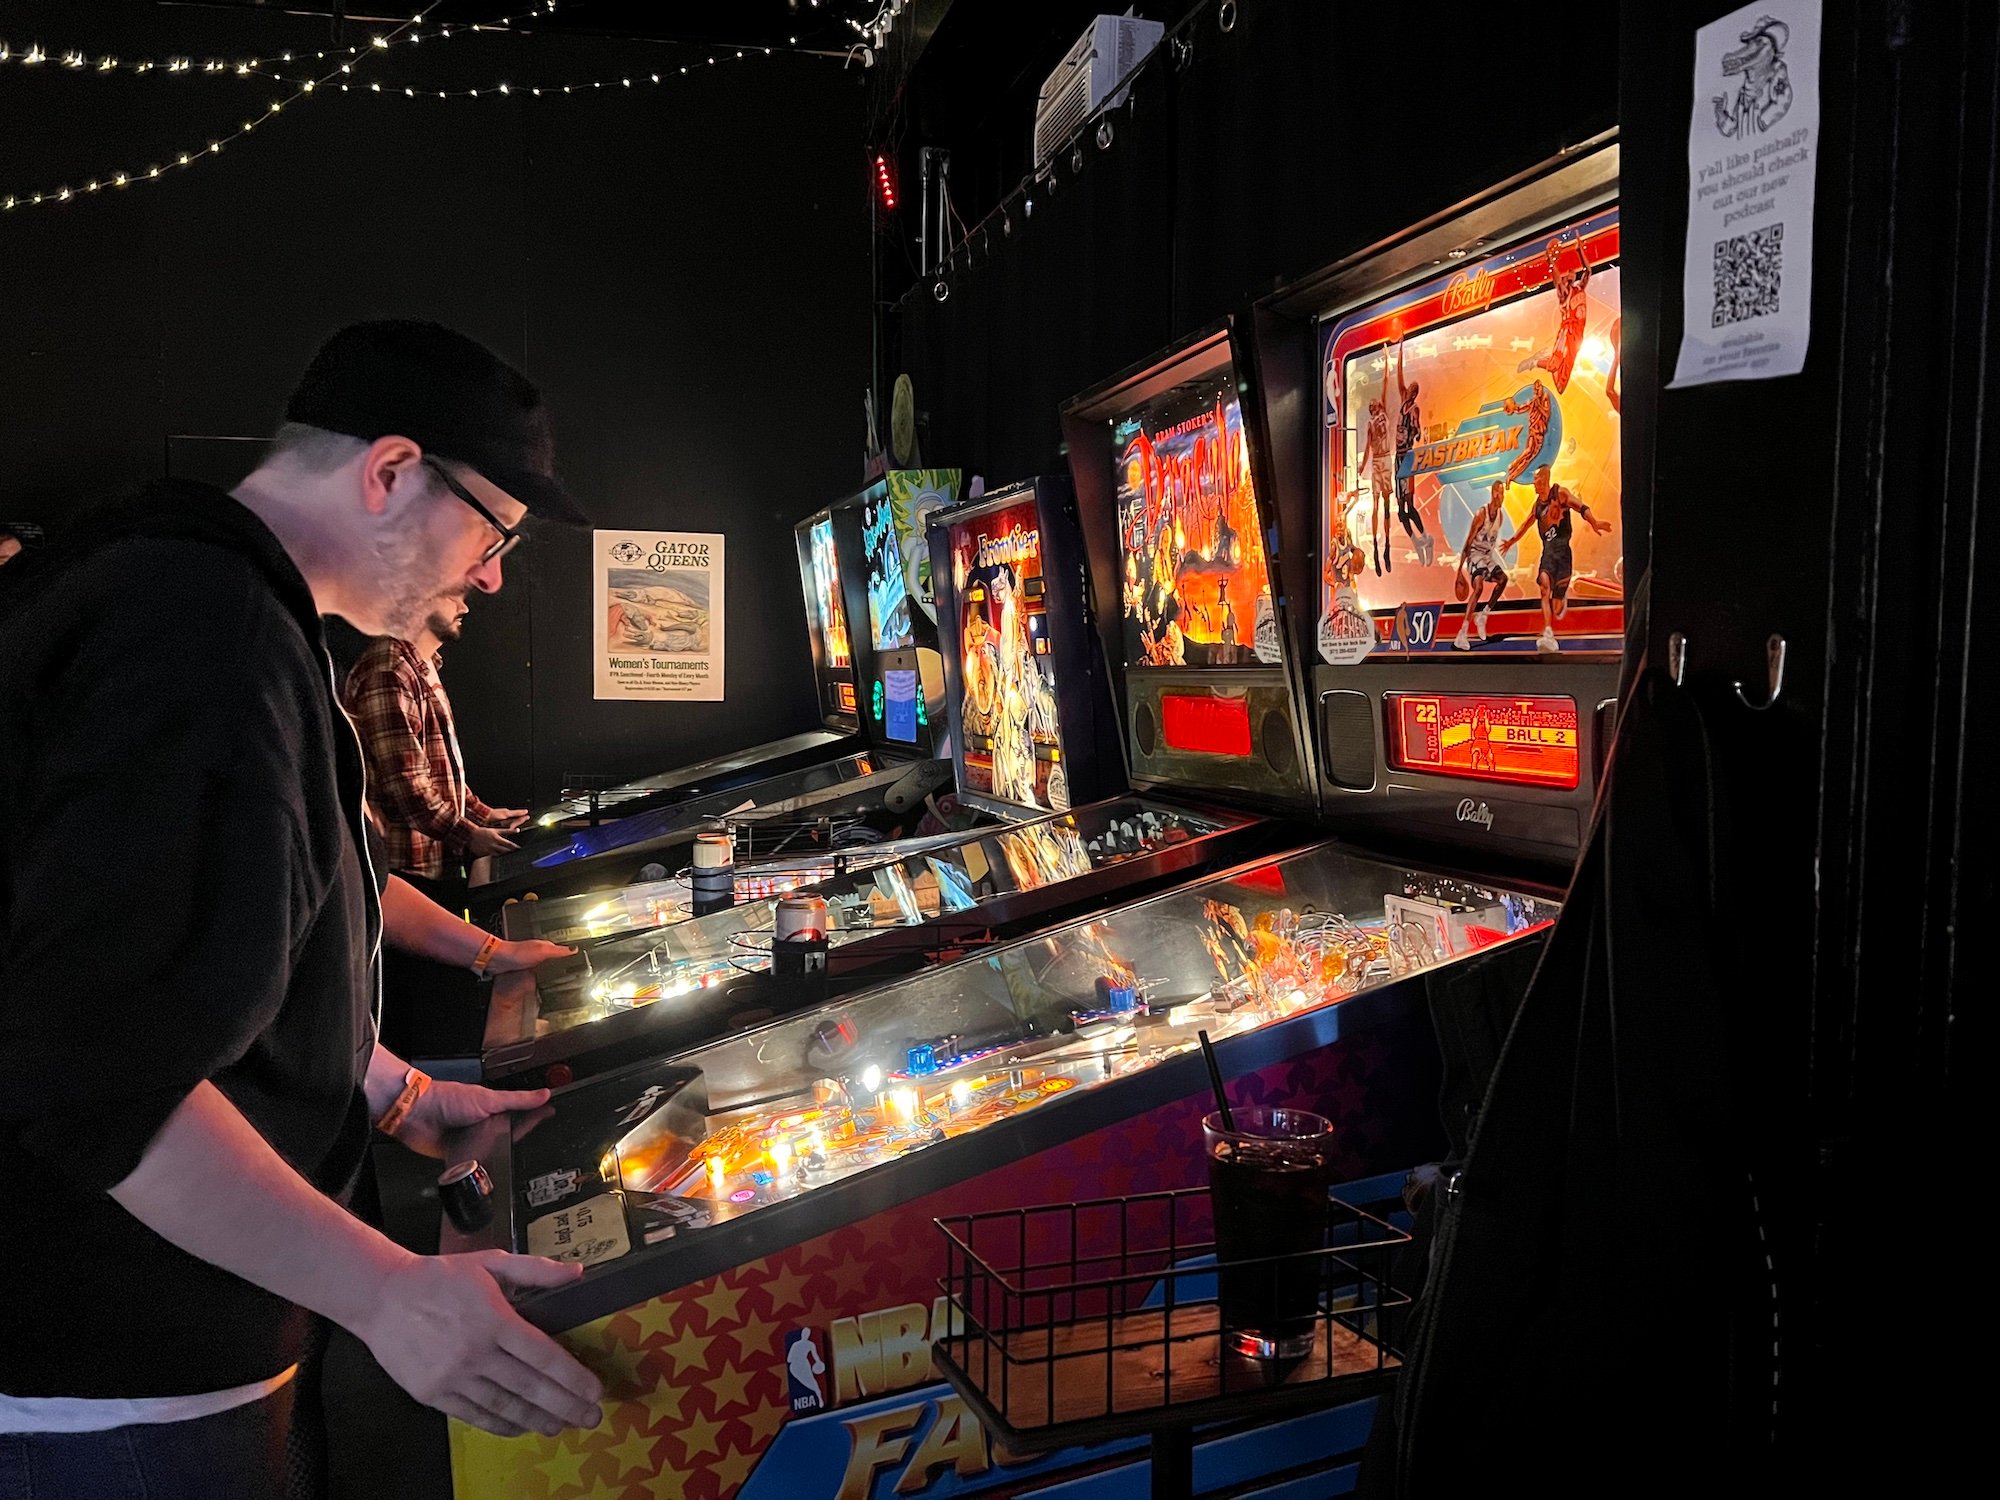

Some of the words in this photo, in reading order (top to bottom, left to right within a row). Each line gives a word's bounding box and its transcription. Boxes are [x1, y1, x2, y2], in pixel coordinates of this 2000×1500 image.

[1697, 160, 1723, 183] y'all
[1726, 153, 1751, 171] like
[1753, 127, 1810, 163] pinball?
[1697, 183, 1719, 202] you
[1721, 163, 1765, 190] should
[1768, 147, 1810, 173] check
[1712, 194, 1734, 211] out
[1736, 186, 1759, 203] our
[1762, 175, 1791, 194] new
[1723, 197, 1776, 228] podcast
[1441, 272, 1496, 317] Bally
[1155, 427, 1176, 443] BRAM
[1176, 410, 1216, 437] STOKER'S
[1410, 424, 1524, 472] FASTBREAK
[655, 540, 710, 556] GATOR
[977, 524, 1039, 568] Frontier
[1545, 526, 1558, 542] 32
[645, 553, 711, 573] QUEENS
[1408, 610, 1434, 645] 50
[608, 657, 650, 670] Women's
[651, 658, 710, 671] Tournaments
[1416, 704, 1437, 723] 22
[1506, 729, 1548, 743] BALL
[1555, 731, 1566, 744] 2
[1456, 797, 1496, 831] Bally
[794, 1394, 816, 1410] NBA
